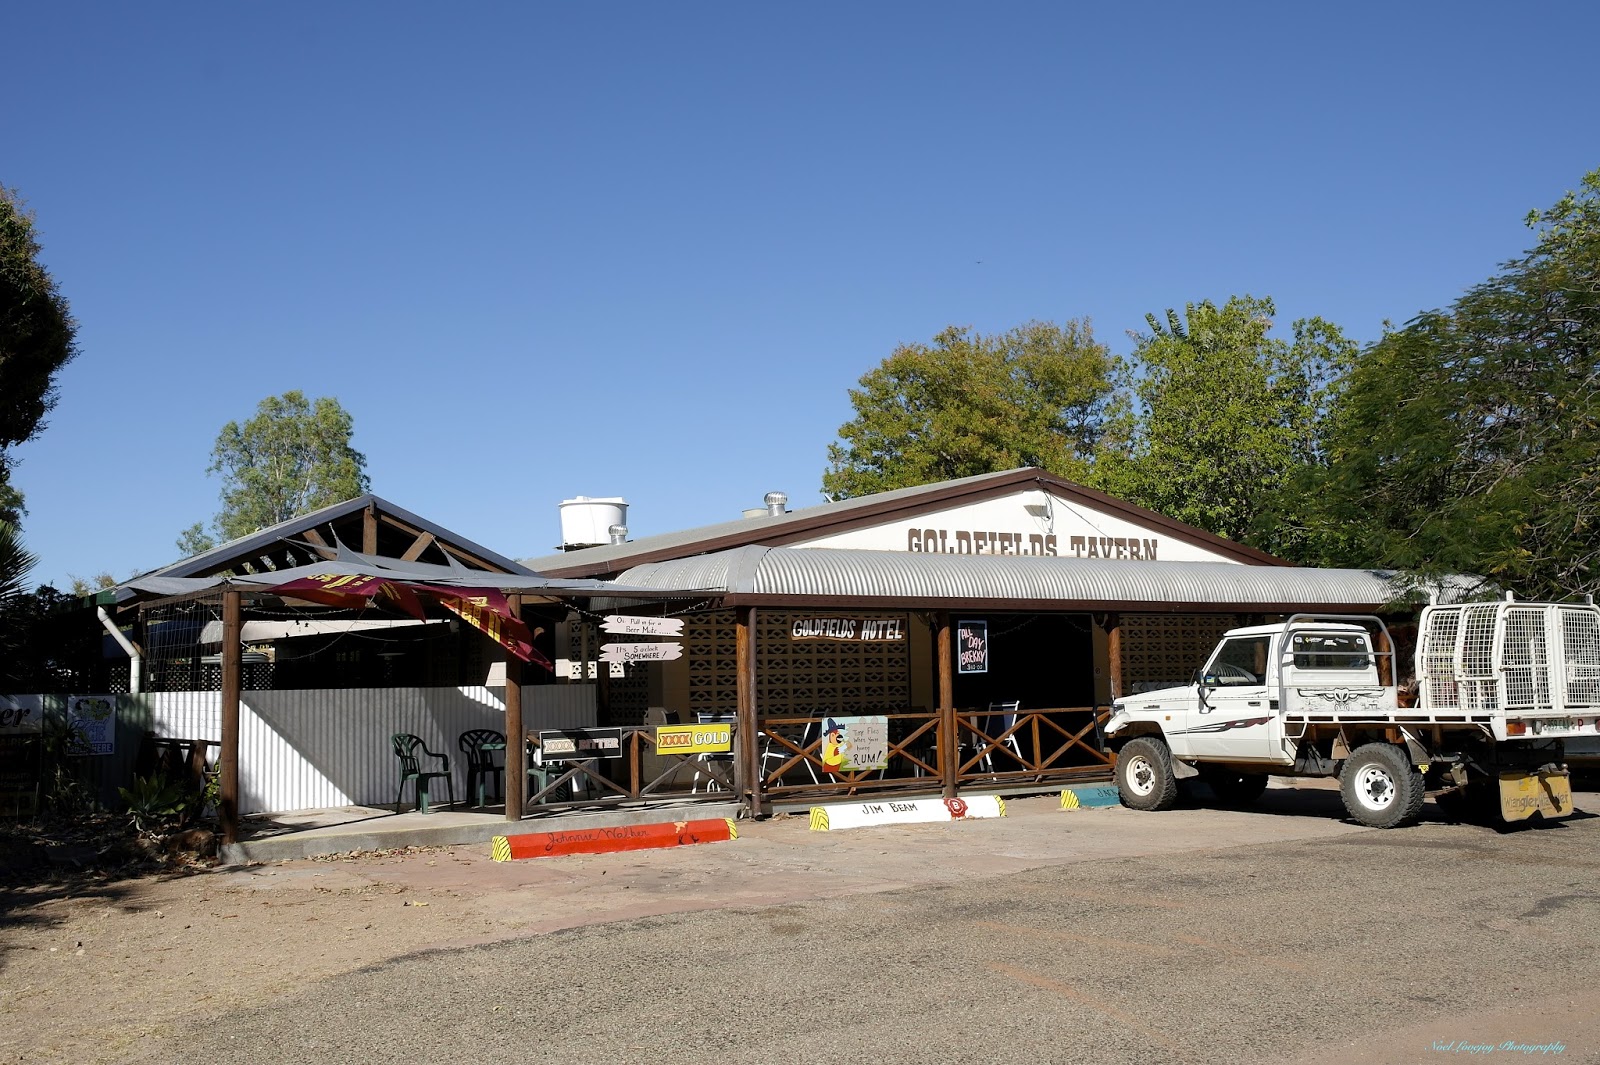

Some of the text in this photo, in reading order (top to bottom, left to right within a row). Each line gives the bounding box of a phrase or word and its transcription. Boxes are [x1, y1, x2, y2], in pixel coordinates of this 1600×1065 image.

[908, 528, 1158, 561] GOLDFIELDS TAVERN
[792, 618, 902, 640] GOLDFIELDS HOTEL
[961, 628, 973, 640] ALL
[633, 645, 639, 653] 5
[968, 636, 984, 650] DAY
[960, 649, 986, 666] BREKKY
[545, 738, 619, 751] XXXX BITTER
[661, 731, 729, 746] XXXX GOLD
[853, 750, 882, 766] RUM!
[862, 804, 884, 815] JIM
[888, 802, 918, 813] BEAM
[1504, 794, 1538, 813] Wrangler
